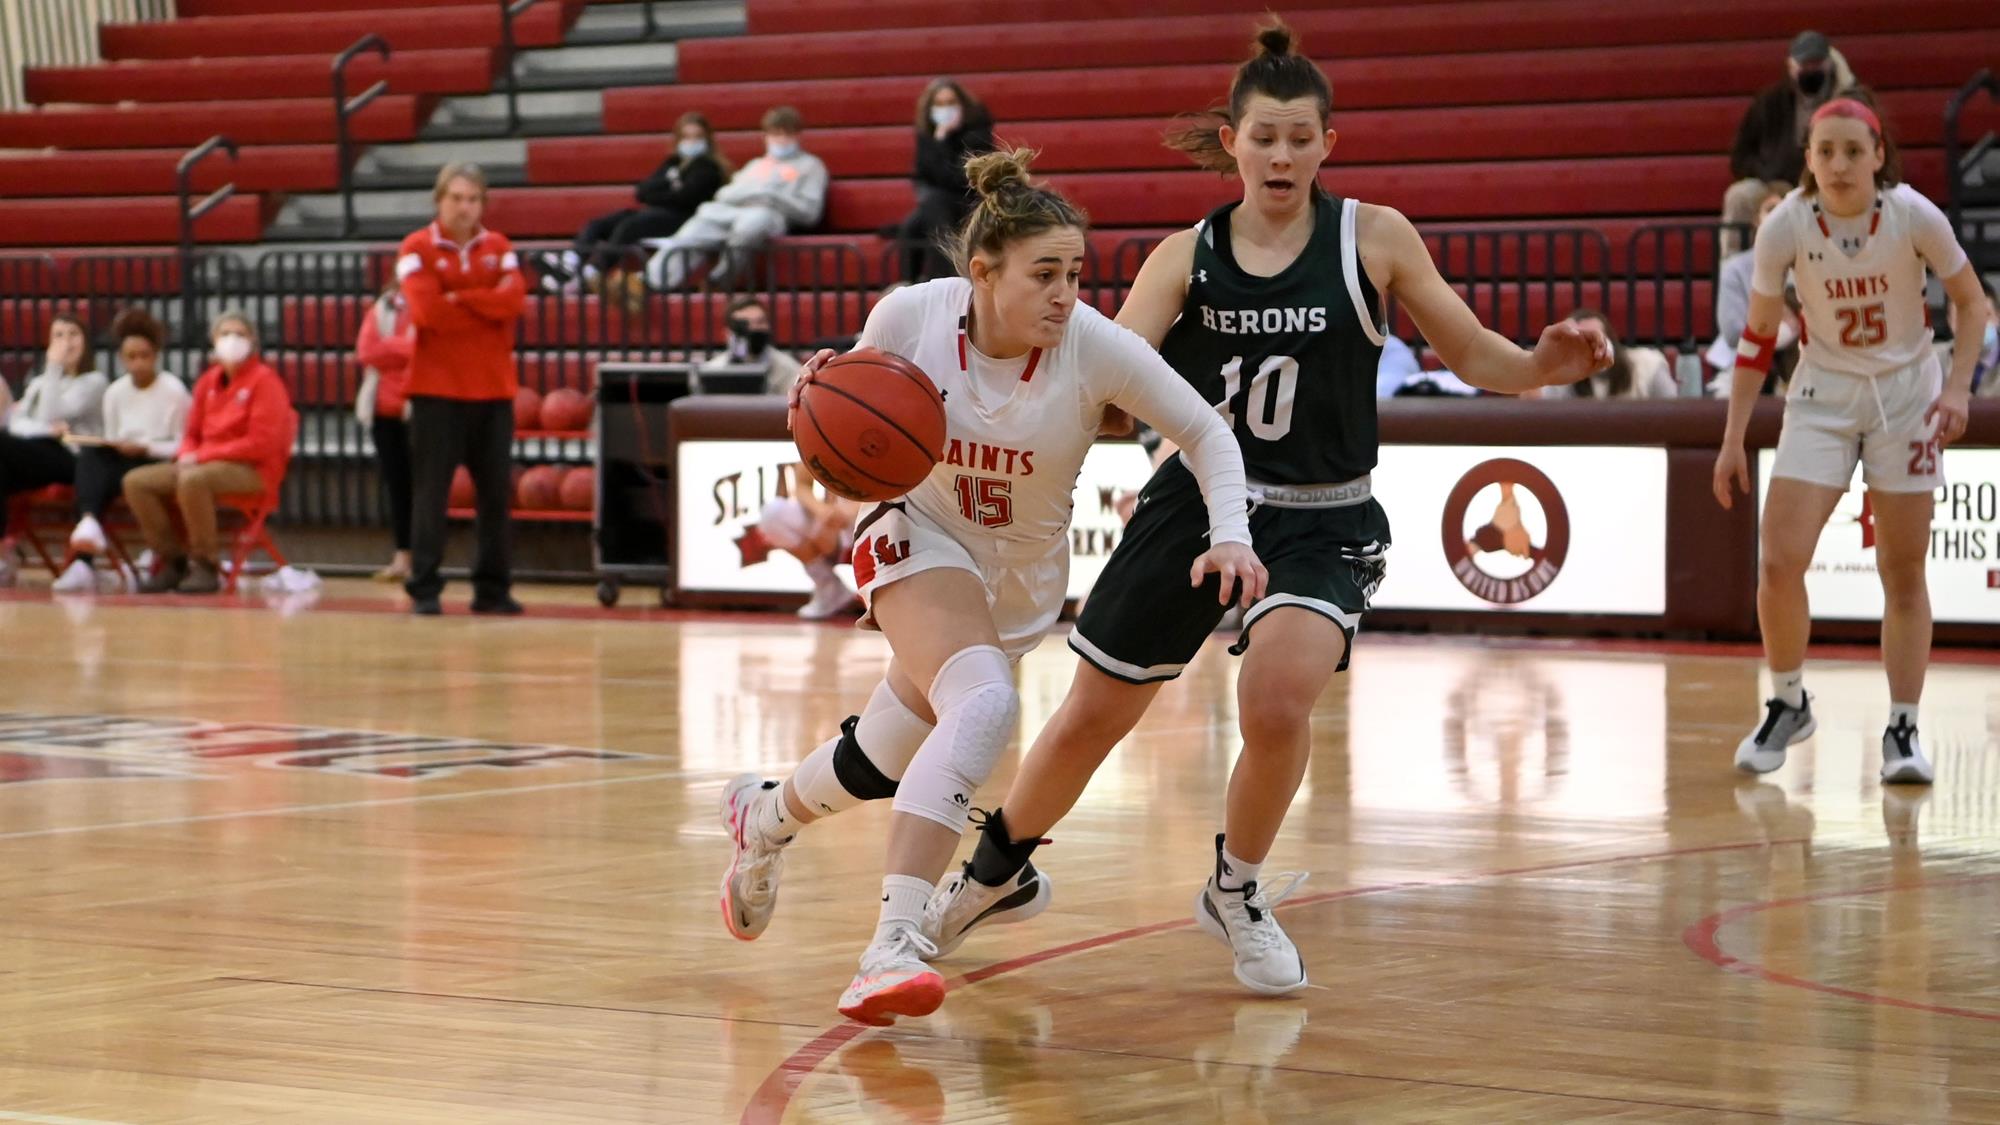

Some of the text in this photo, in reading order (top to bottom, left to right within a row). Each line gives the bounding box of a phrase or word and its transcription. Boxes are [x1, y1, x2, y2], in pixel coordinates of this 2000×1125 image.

[1824, 273, 1888, 299] SAINTS
[1200, 306, 1327, 334] HERONS
[1835, 301, 1888, 347] 25
[1214, 355, 1299, 441] 10
[940, 438, 1034, 476] AINTS
[1907, 440, 1937, 476] 25
[953, 474, 1013, 529] 15
[1931, 528, 1986, 561] THIS
